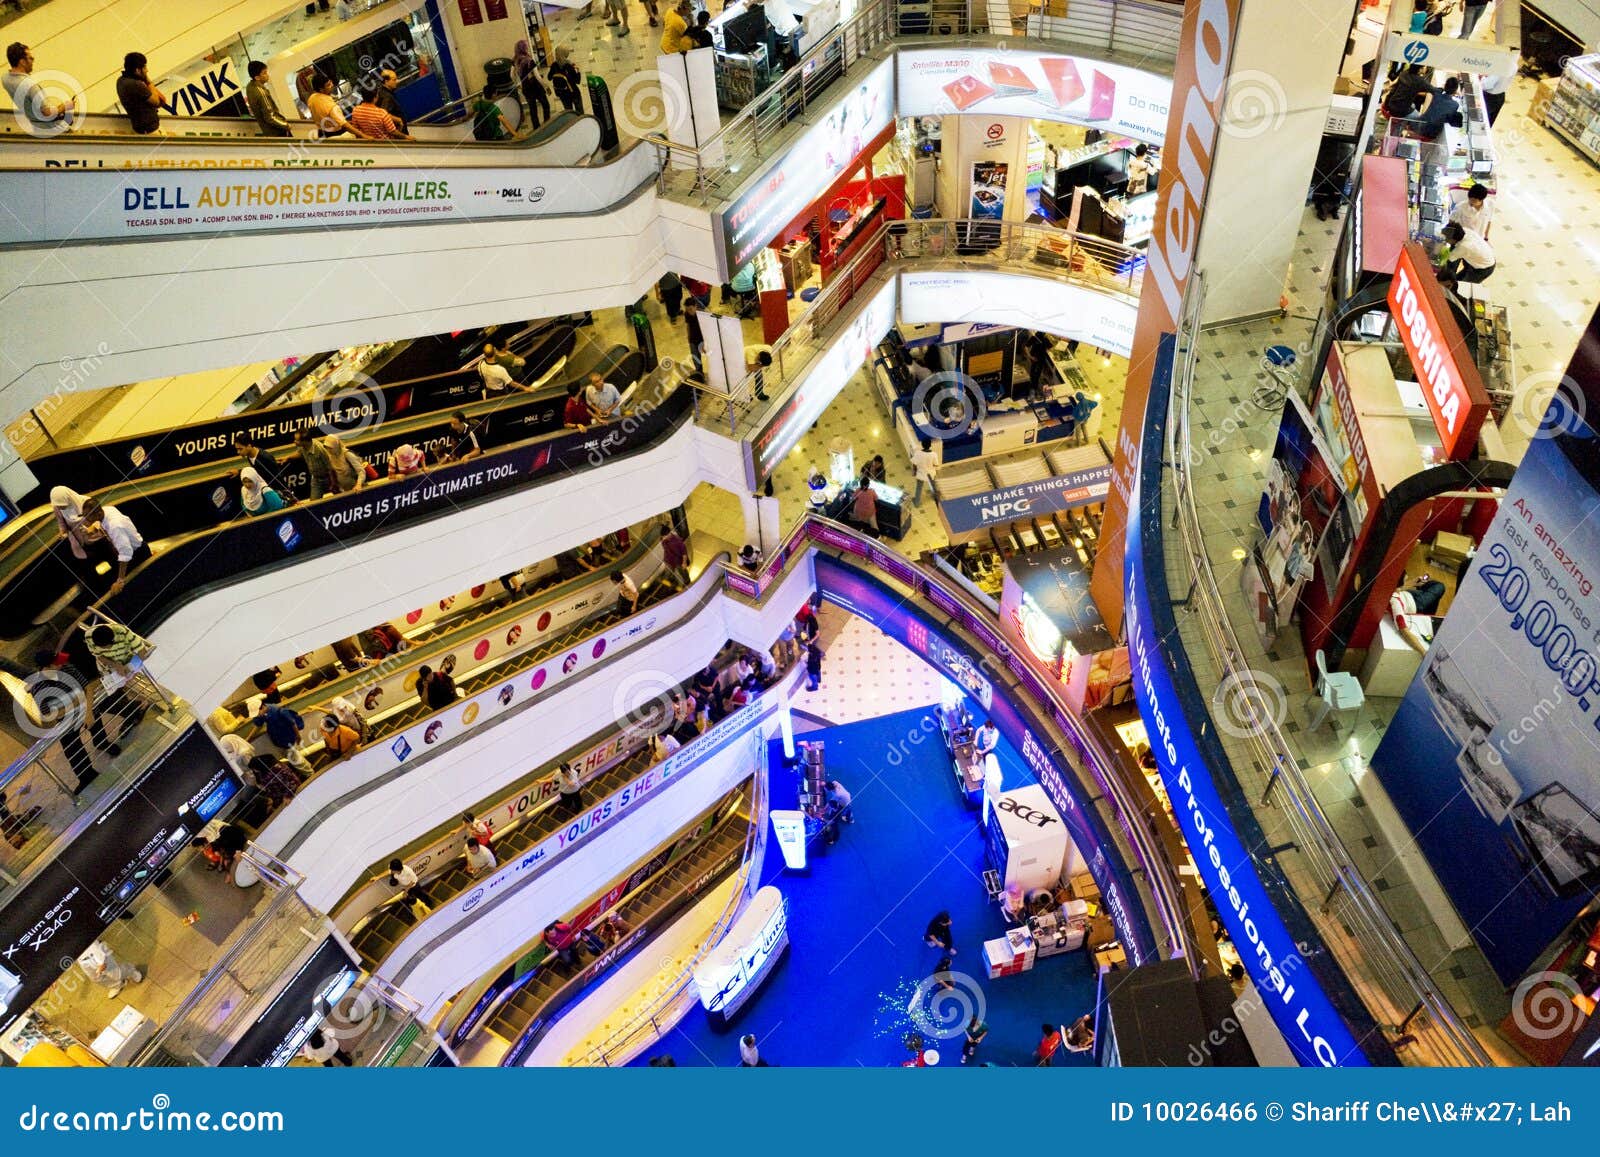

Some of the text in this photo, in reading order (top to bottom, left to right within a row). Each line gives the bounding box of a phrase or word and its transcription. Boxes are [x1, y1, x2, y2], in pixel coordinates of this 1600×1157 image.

[1406, 40, 1428, 63] hp
[1462, 57, 1493, 69] Mobility
[123, 181, 451, 210] DELL AUTHORISED RETAILERS.
[502, 188, 522, 198] DELL
[126, 219, 157, 228] TECASIA
[160, 218, 176, 226] SDN.
[177, 217, 193, 225] BHD
[202, 215, 225, 223] ACOMP
[227, 214, 242, 222] LINK
[260, 213, 273, 221] BHD
[1390, 267, 1460, 436] TOSHIBA
[175, 434, 227, 457] YOURS
[249, 424, 276, 442] THE
[279, 410, 342, 435] ULTIMATE
[345, 403, 379, 421] TOOL.
[1335, 370, 1368, 483] TOSHIBA
[322, 463, 518, 531] YOURS IS THE ULTIMATE TOOL.
[972, 495, 989, 507] WE
[992, 487, 1025, 503] MAKE
[1027, 478, 1070, 495] THINGS
[1513, 497, 1593, 597] An amazing
[1502, 517, 1529, 554] fast
[1528, 550, 1591, 630] response
[188, 768, 225, 805] Windows Vista
[507, 778, 560, 819] YOURS
[586, 736, 625, 770] HERE
[1022, 740, 1068, 813] Bergaya
[1023, 728, 1075, 810] Sentuhan
[558, 803, 612, 849] YOURS
[615, 788, 631, 812] IS
[633, 761, 673, 799] HERE
[998, 796, 1058, 829] acer
[1134, 622, 1178, 767] Ultimate
[1178, 765, 1295, 1004] Professional
[137, 828, 167, 860] AESTHETIC
[521, 848, 545, 869] DELL
[45, 886, 80, 920] Series
[463, 888, 484, 911] intel
[29, 909, 73, 952] X340
